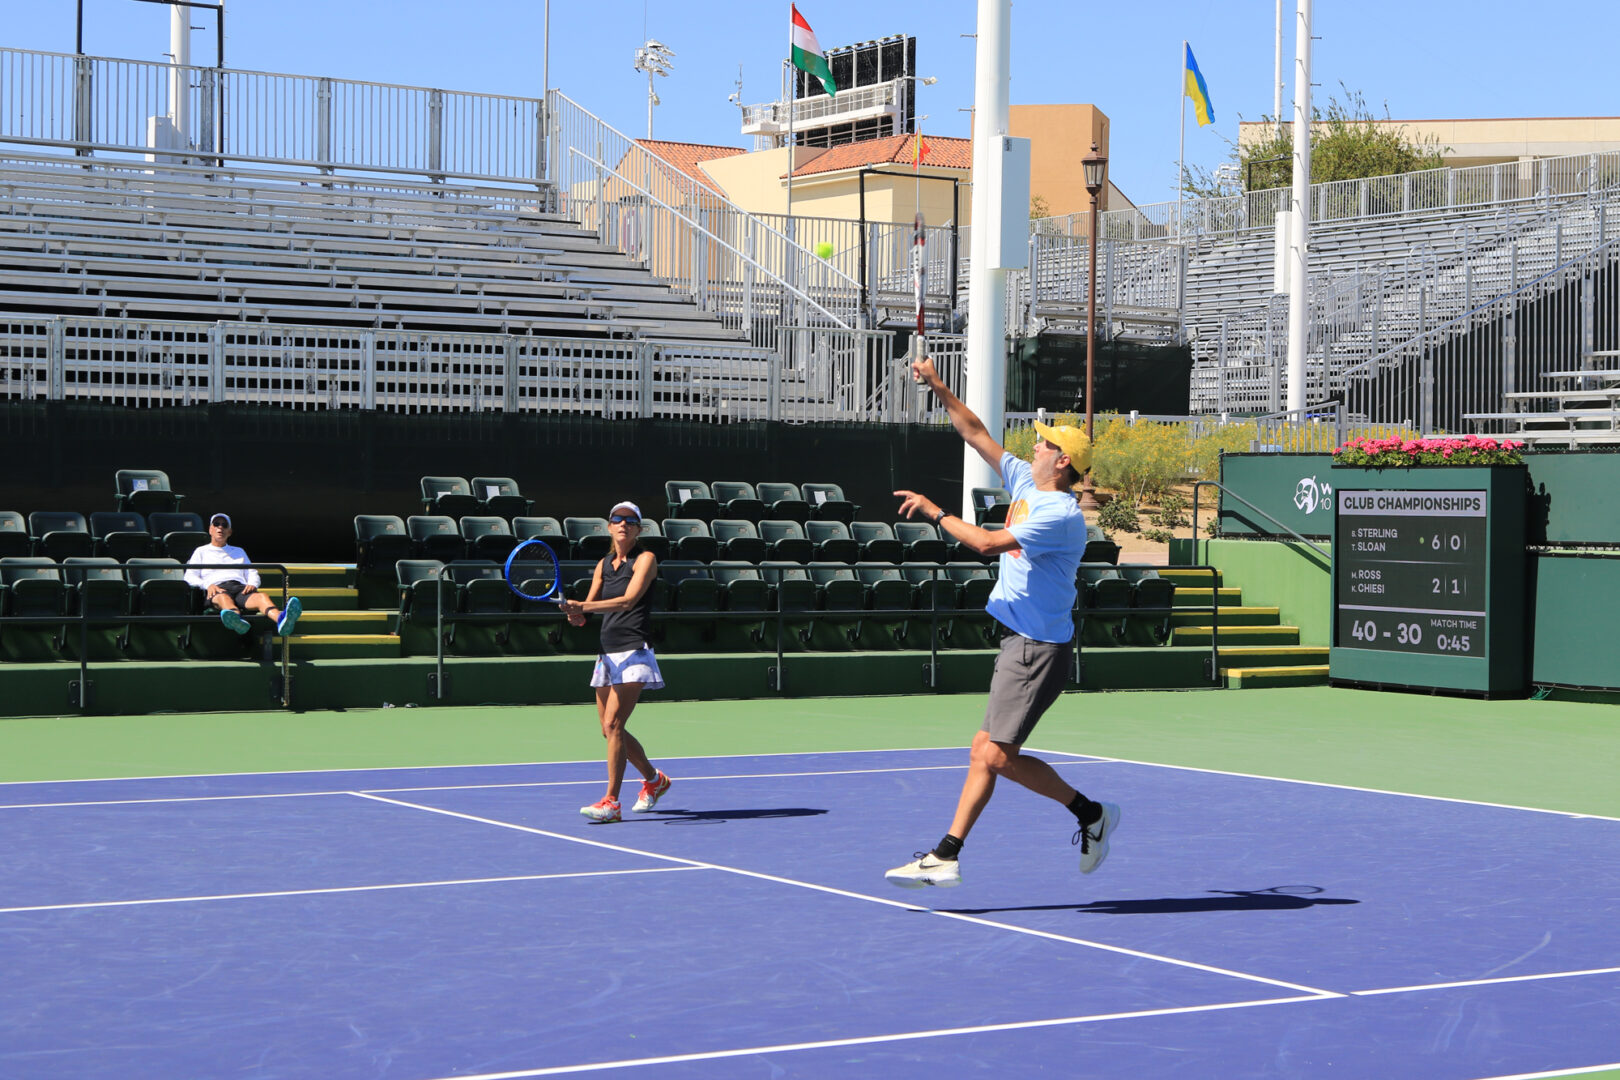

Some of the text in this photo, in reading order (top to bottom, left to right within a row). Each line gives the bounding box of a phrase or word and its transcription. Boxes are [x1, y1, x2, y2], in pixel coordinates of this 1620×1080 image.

[1344, 497, 1481, 511] CLUB CHAMPIONSHIPS
[1357, 528, 1398, 538] STERLING
[1351, 541, 1386, 551] T. SLOAN
[1431, 534, 1461, 550] 6 0
[1358, 569, 1382, 580] ROSS
[1358, 583, 1385, 594] CHIESI
[1432, 578, 1460, 594] 2 1
[1430, 618, 1477, 630] MATCH TIME
[1352, 620, 1377, 642] 40
[1397, 622, 1422, 645] 30
[1437, 634, 1470, 651] 0:45
